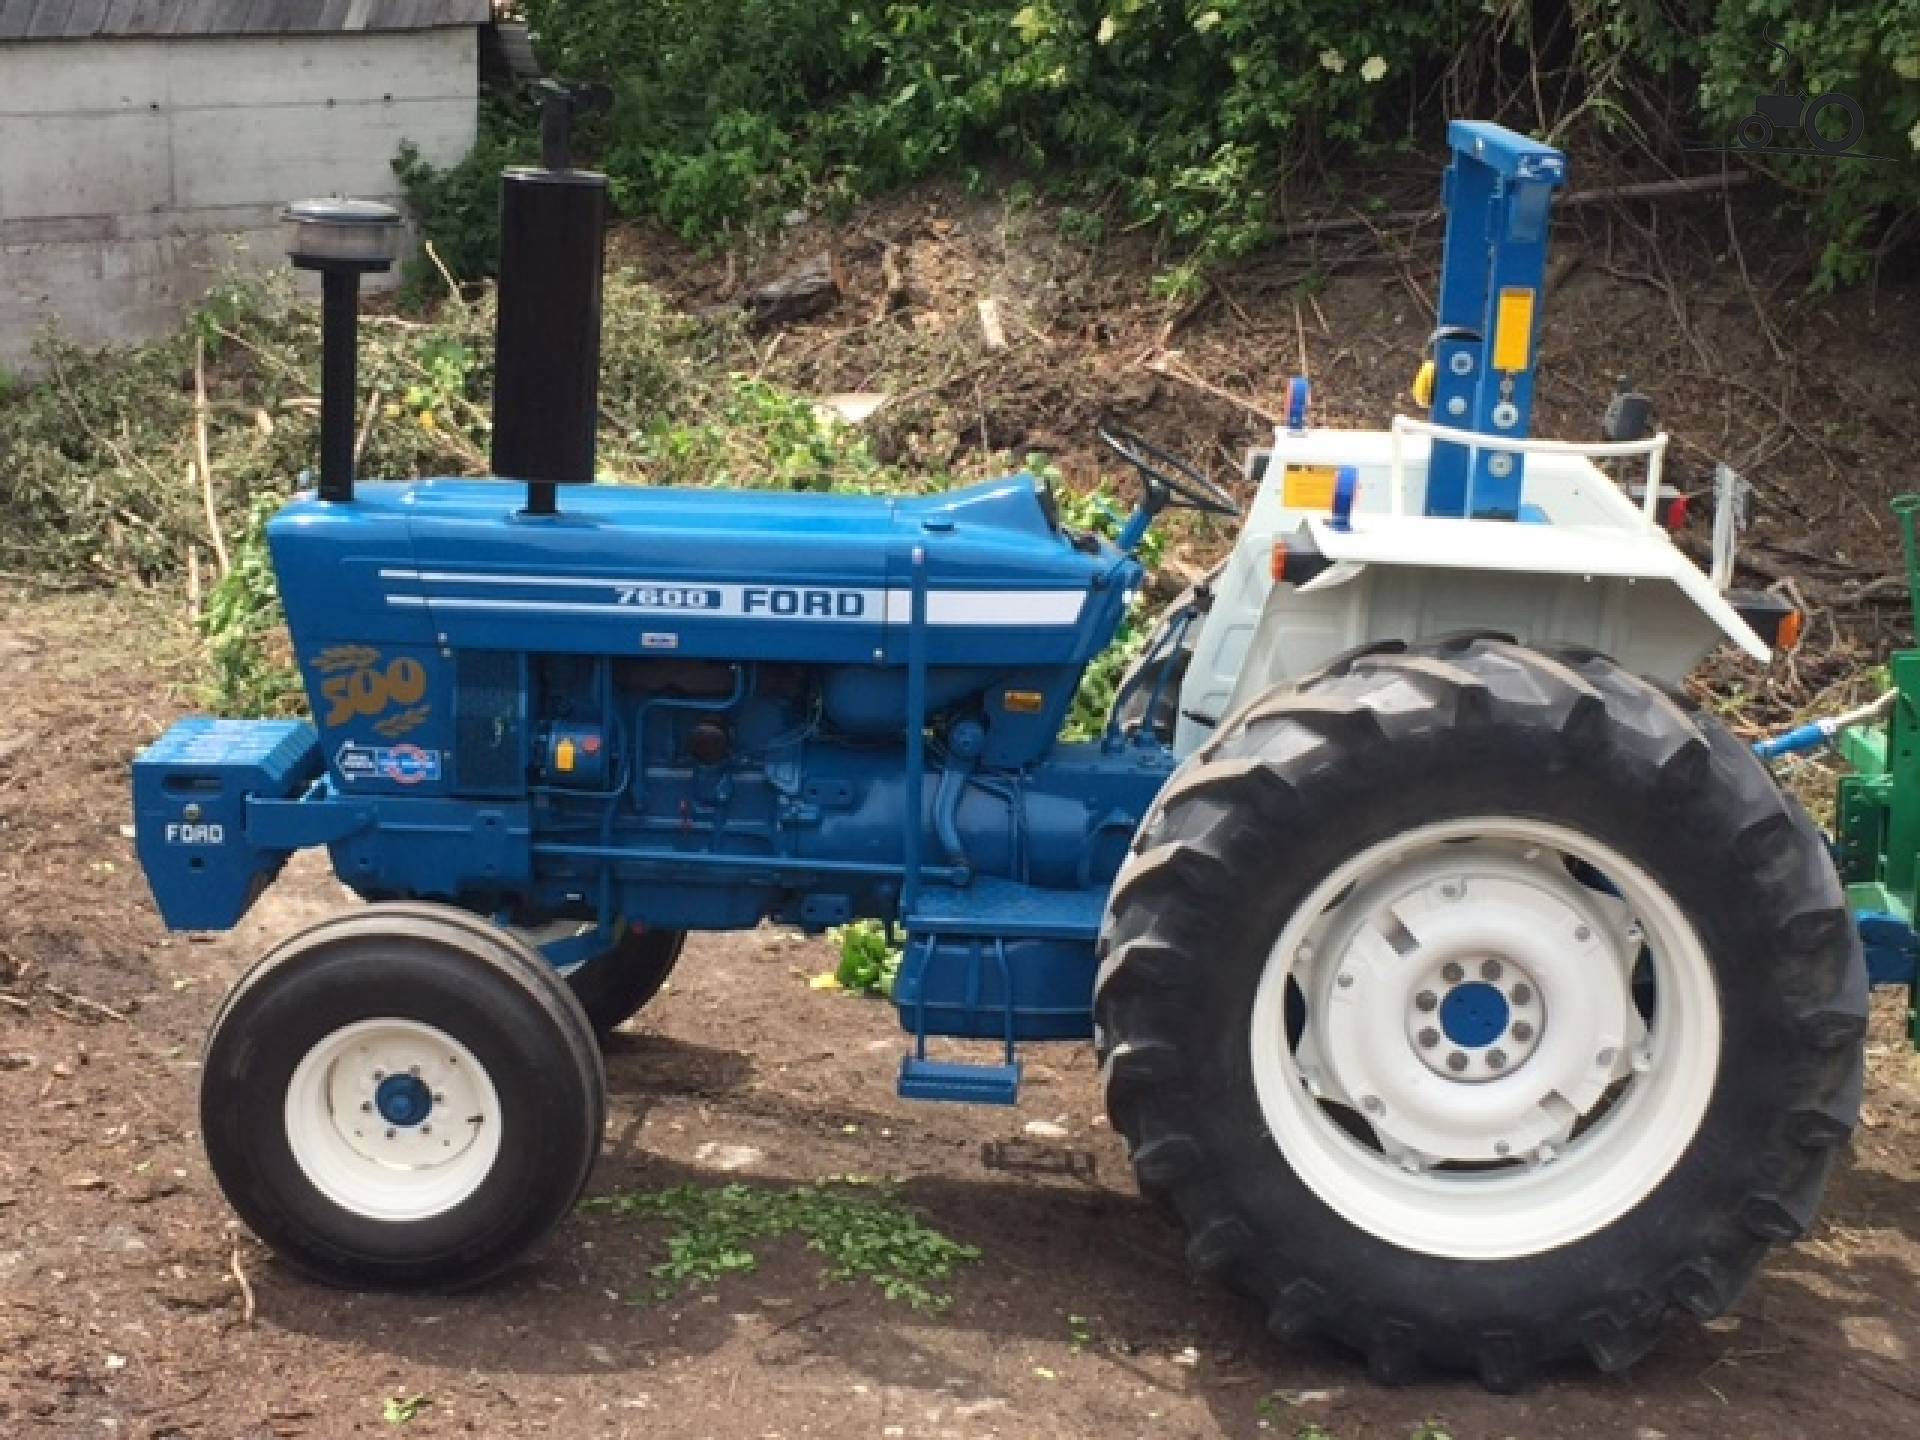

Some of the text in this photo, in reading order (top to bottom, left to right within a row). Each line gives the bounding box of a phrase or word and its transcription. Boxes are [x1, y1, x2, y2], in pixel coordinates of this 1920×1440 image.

[743, 590, 865, 616] FORD
[322, 657, 427, 727] 500
[166, 824, 225, 844] FORD
